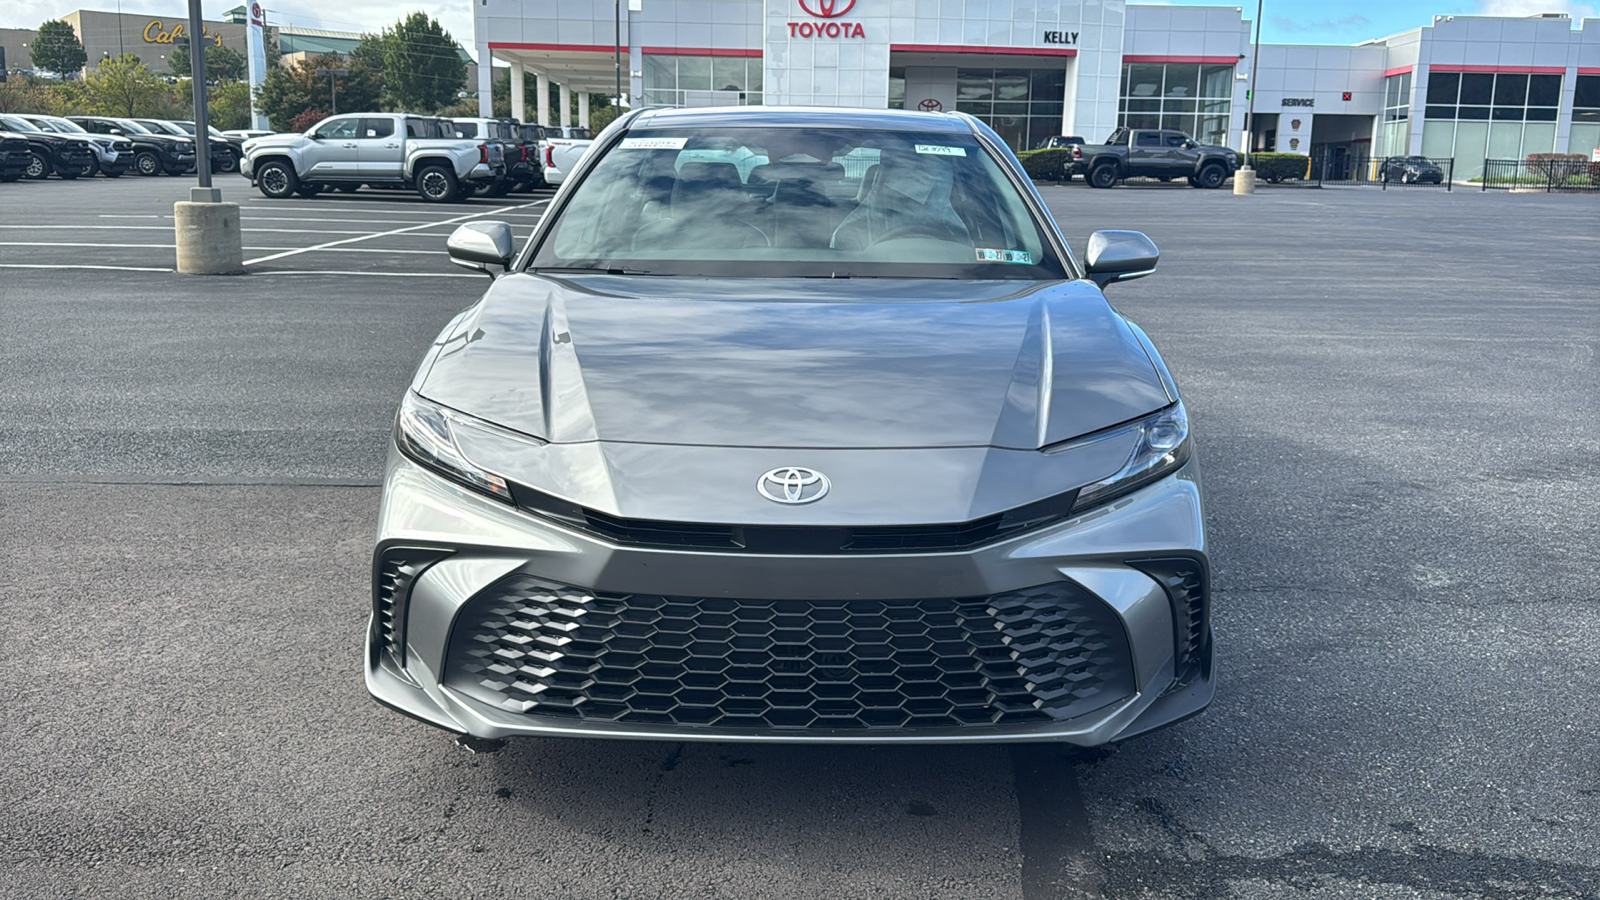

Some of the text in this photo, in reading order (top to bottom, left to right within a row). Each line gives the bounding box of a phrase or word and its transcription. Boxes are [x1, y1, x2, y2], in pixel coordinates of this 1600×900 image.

[787, 22, 865, 38] TOYOTA
[1044, 31, 1079, 44] KELLY
[1281, 98, 1315, 107] SERVICE
